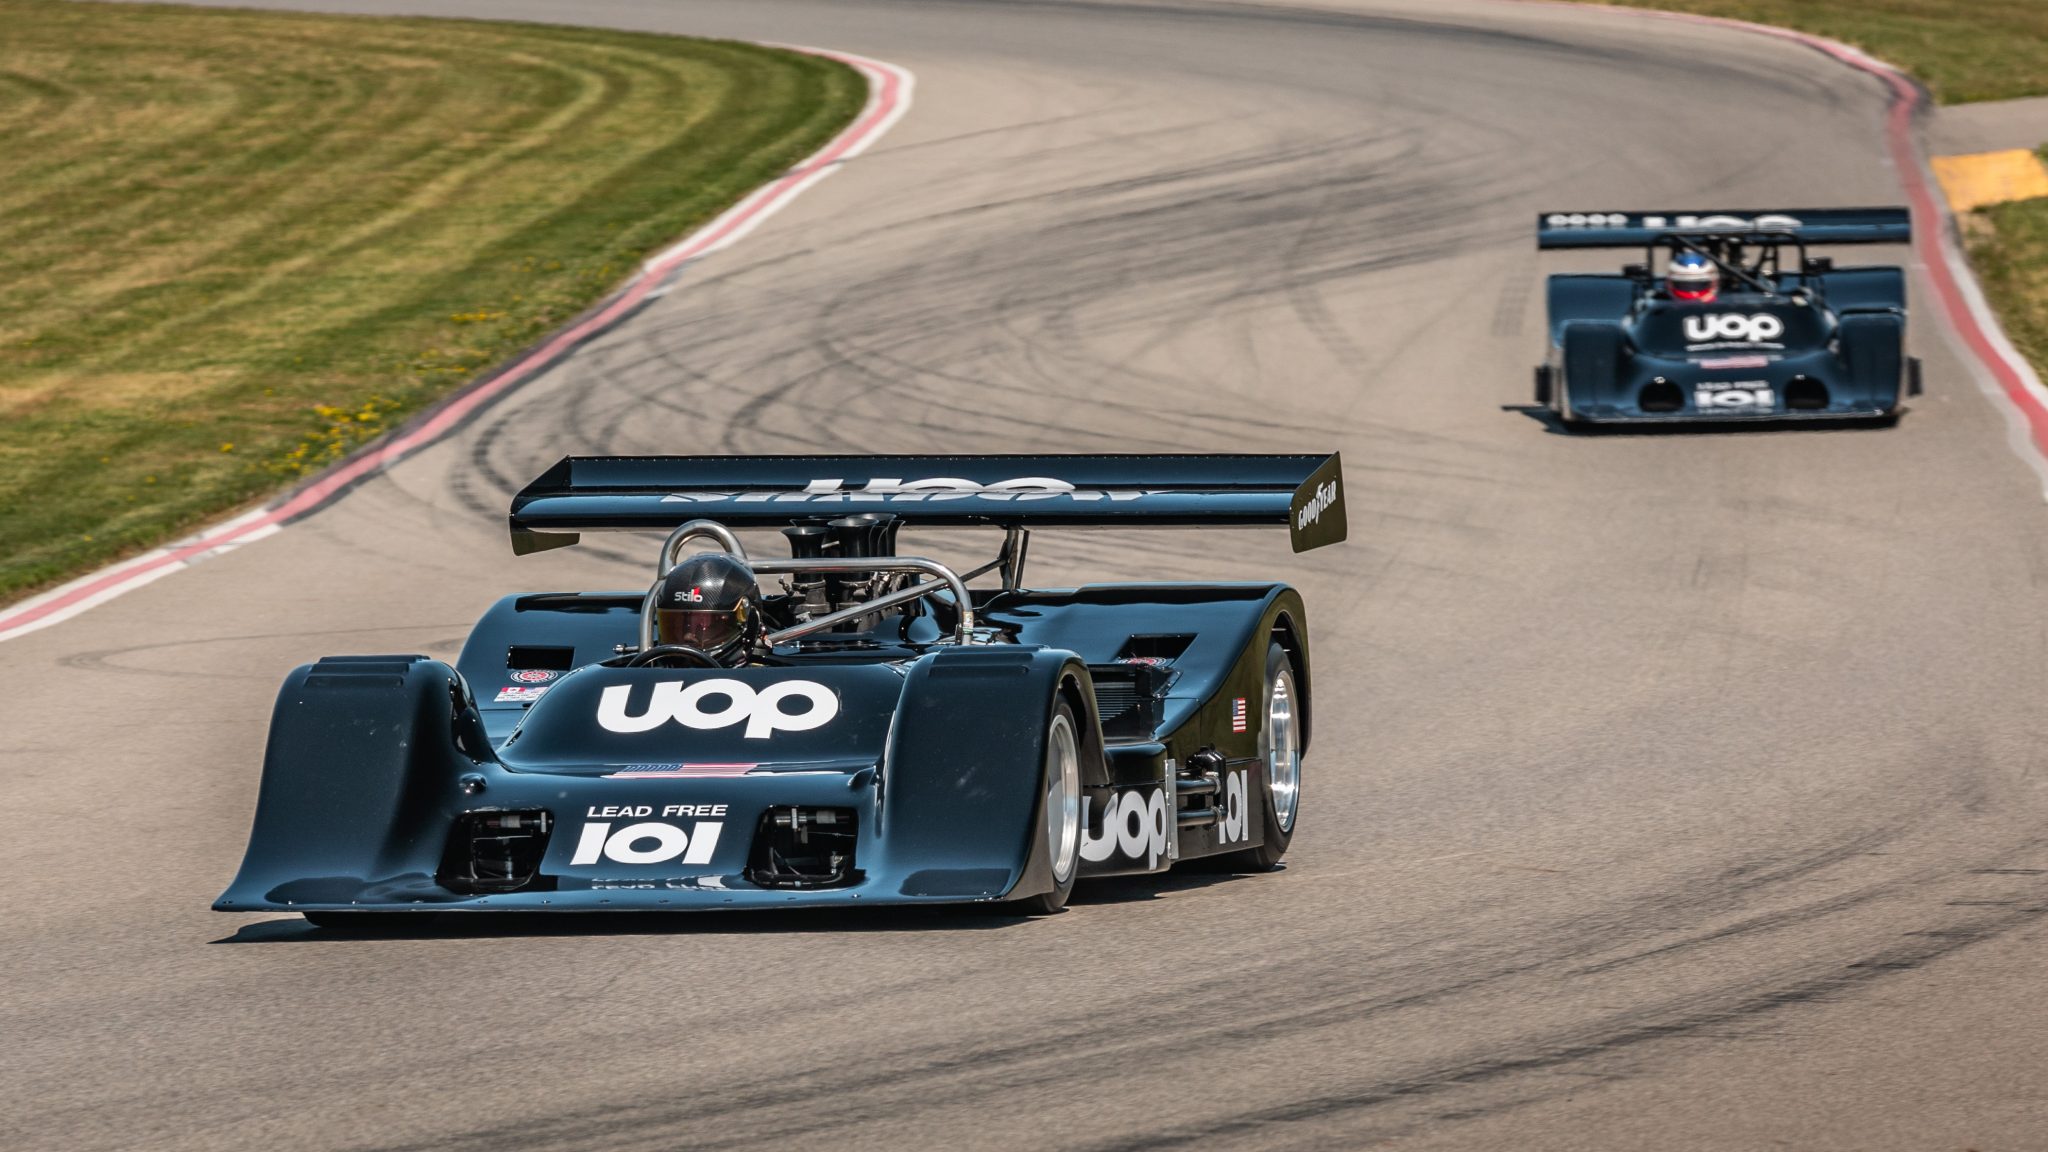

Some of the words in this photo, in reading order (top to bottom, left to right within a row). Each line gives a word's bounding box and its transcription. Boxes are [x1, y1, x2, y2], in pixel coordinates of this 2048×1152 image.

[1298, 480, 1336, 531] GOODYEAR
[586, 805, 653, 817] LEAD
[662, 804, 729, 817] FREE
